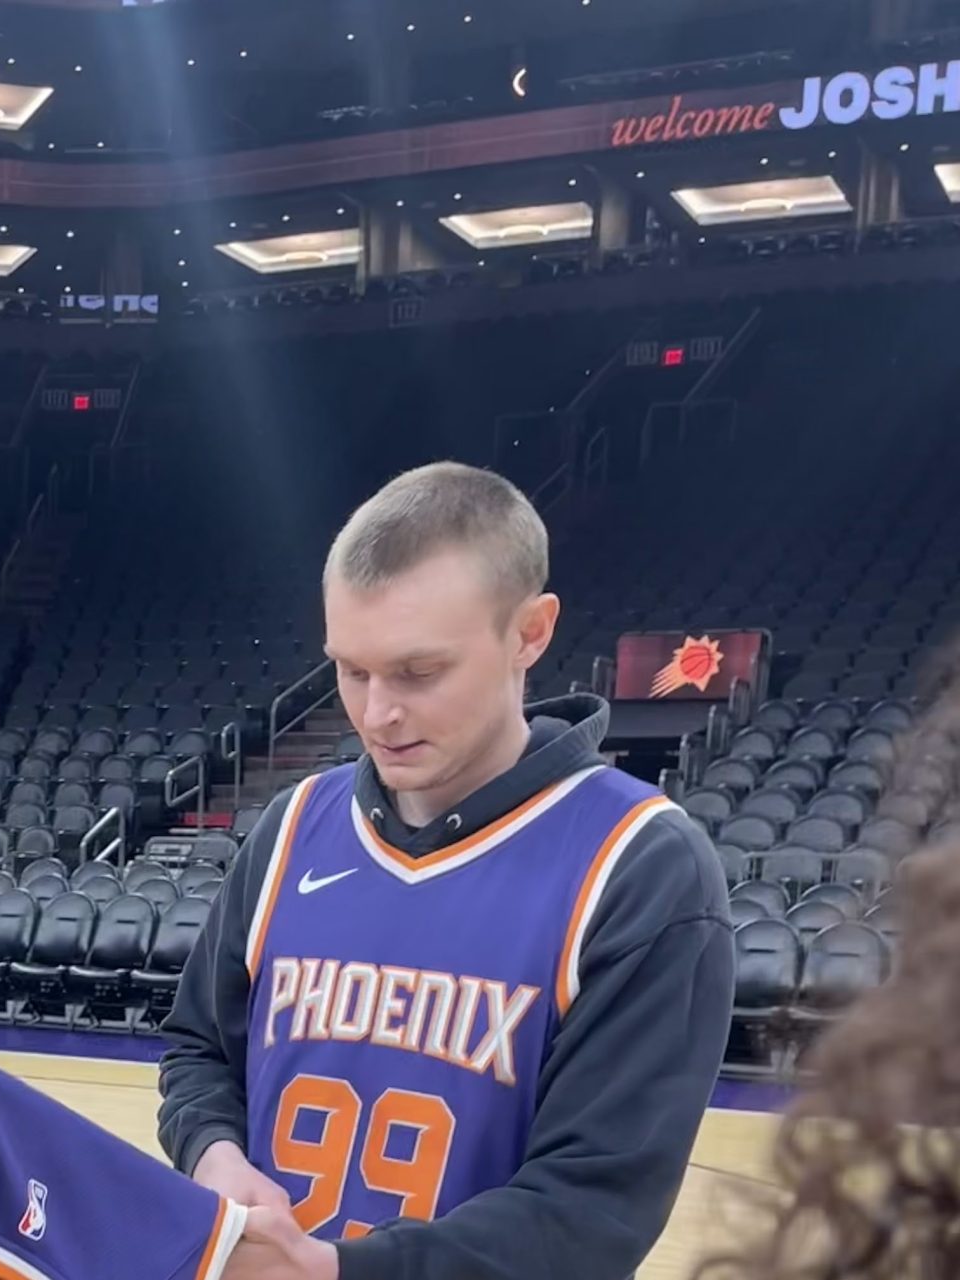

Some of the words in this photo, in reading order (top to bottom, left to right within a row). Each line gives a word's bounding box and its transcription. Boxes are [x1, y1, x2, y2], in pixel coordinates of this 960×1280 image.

[612, 95, 775, 146] welcome
[778, 59, 960, 130] JOSH
[263, 956, 541, 1088] PHOENIX
[271, 1073, 456, 1239] 99
